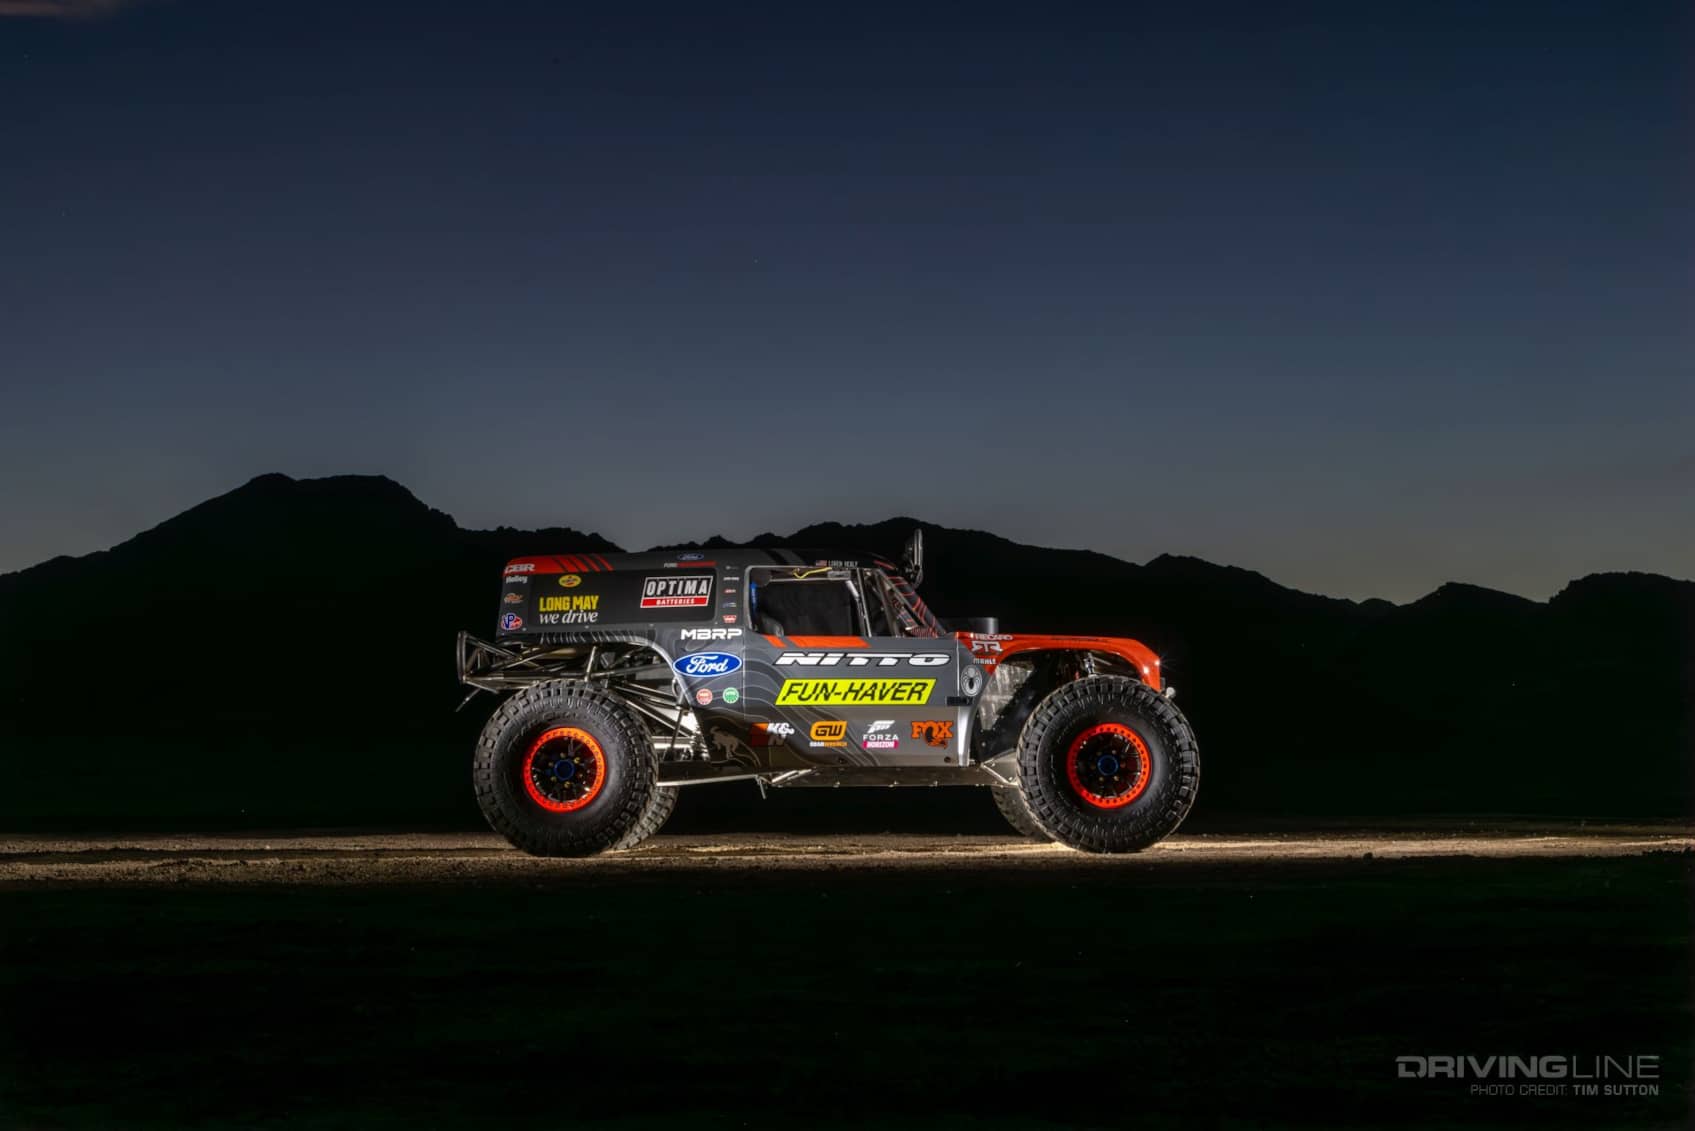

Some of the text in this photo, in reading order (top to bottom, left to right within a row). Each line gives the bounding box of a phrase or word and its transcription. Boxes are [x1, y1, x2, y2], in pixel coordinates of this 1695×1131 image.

[646, 580, 707, 596] OPTIMA
[539, 597, 570, 612] LONG
[573, 595, 599, 610] MAY
[539, 610, 598, 624] we drive
[680, 628, 743, 640] MBRP
[686, 655, 729, 674] Ford
[774, 652, 951, 666] NITTO
[782, 682, 929, 702] FUN-HAVER
[911, 720, 954, 746] FOX
